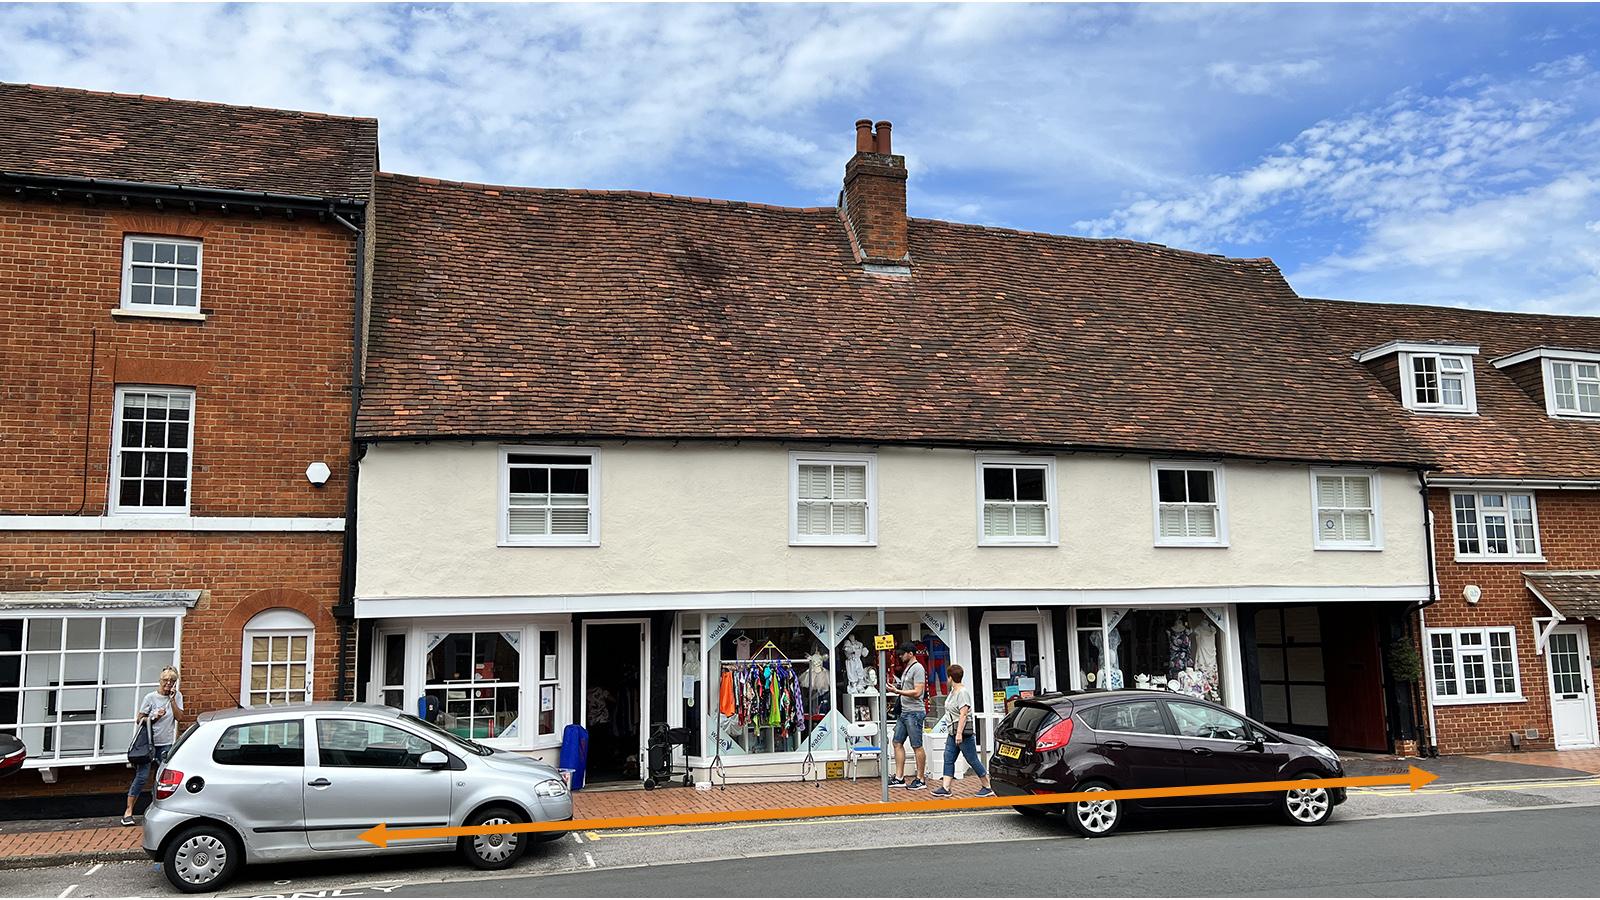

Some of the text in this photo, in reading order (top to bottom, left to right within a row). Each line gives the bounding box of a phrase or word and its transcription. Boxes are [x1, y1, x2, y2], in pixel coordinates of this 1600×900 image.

[710, 622, 726, 639] wade
[805, 615, 820, 631] wade
[836, 620, 851, 637] wade
